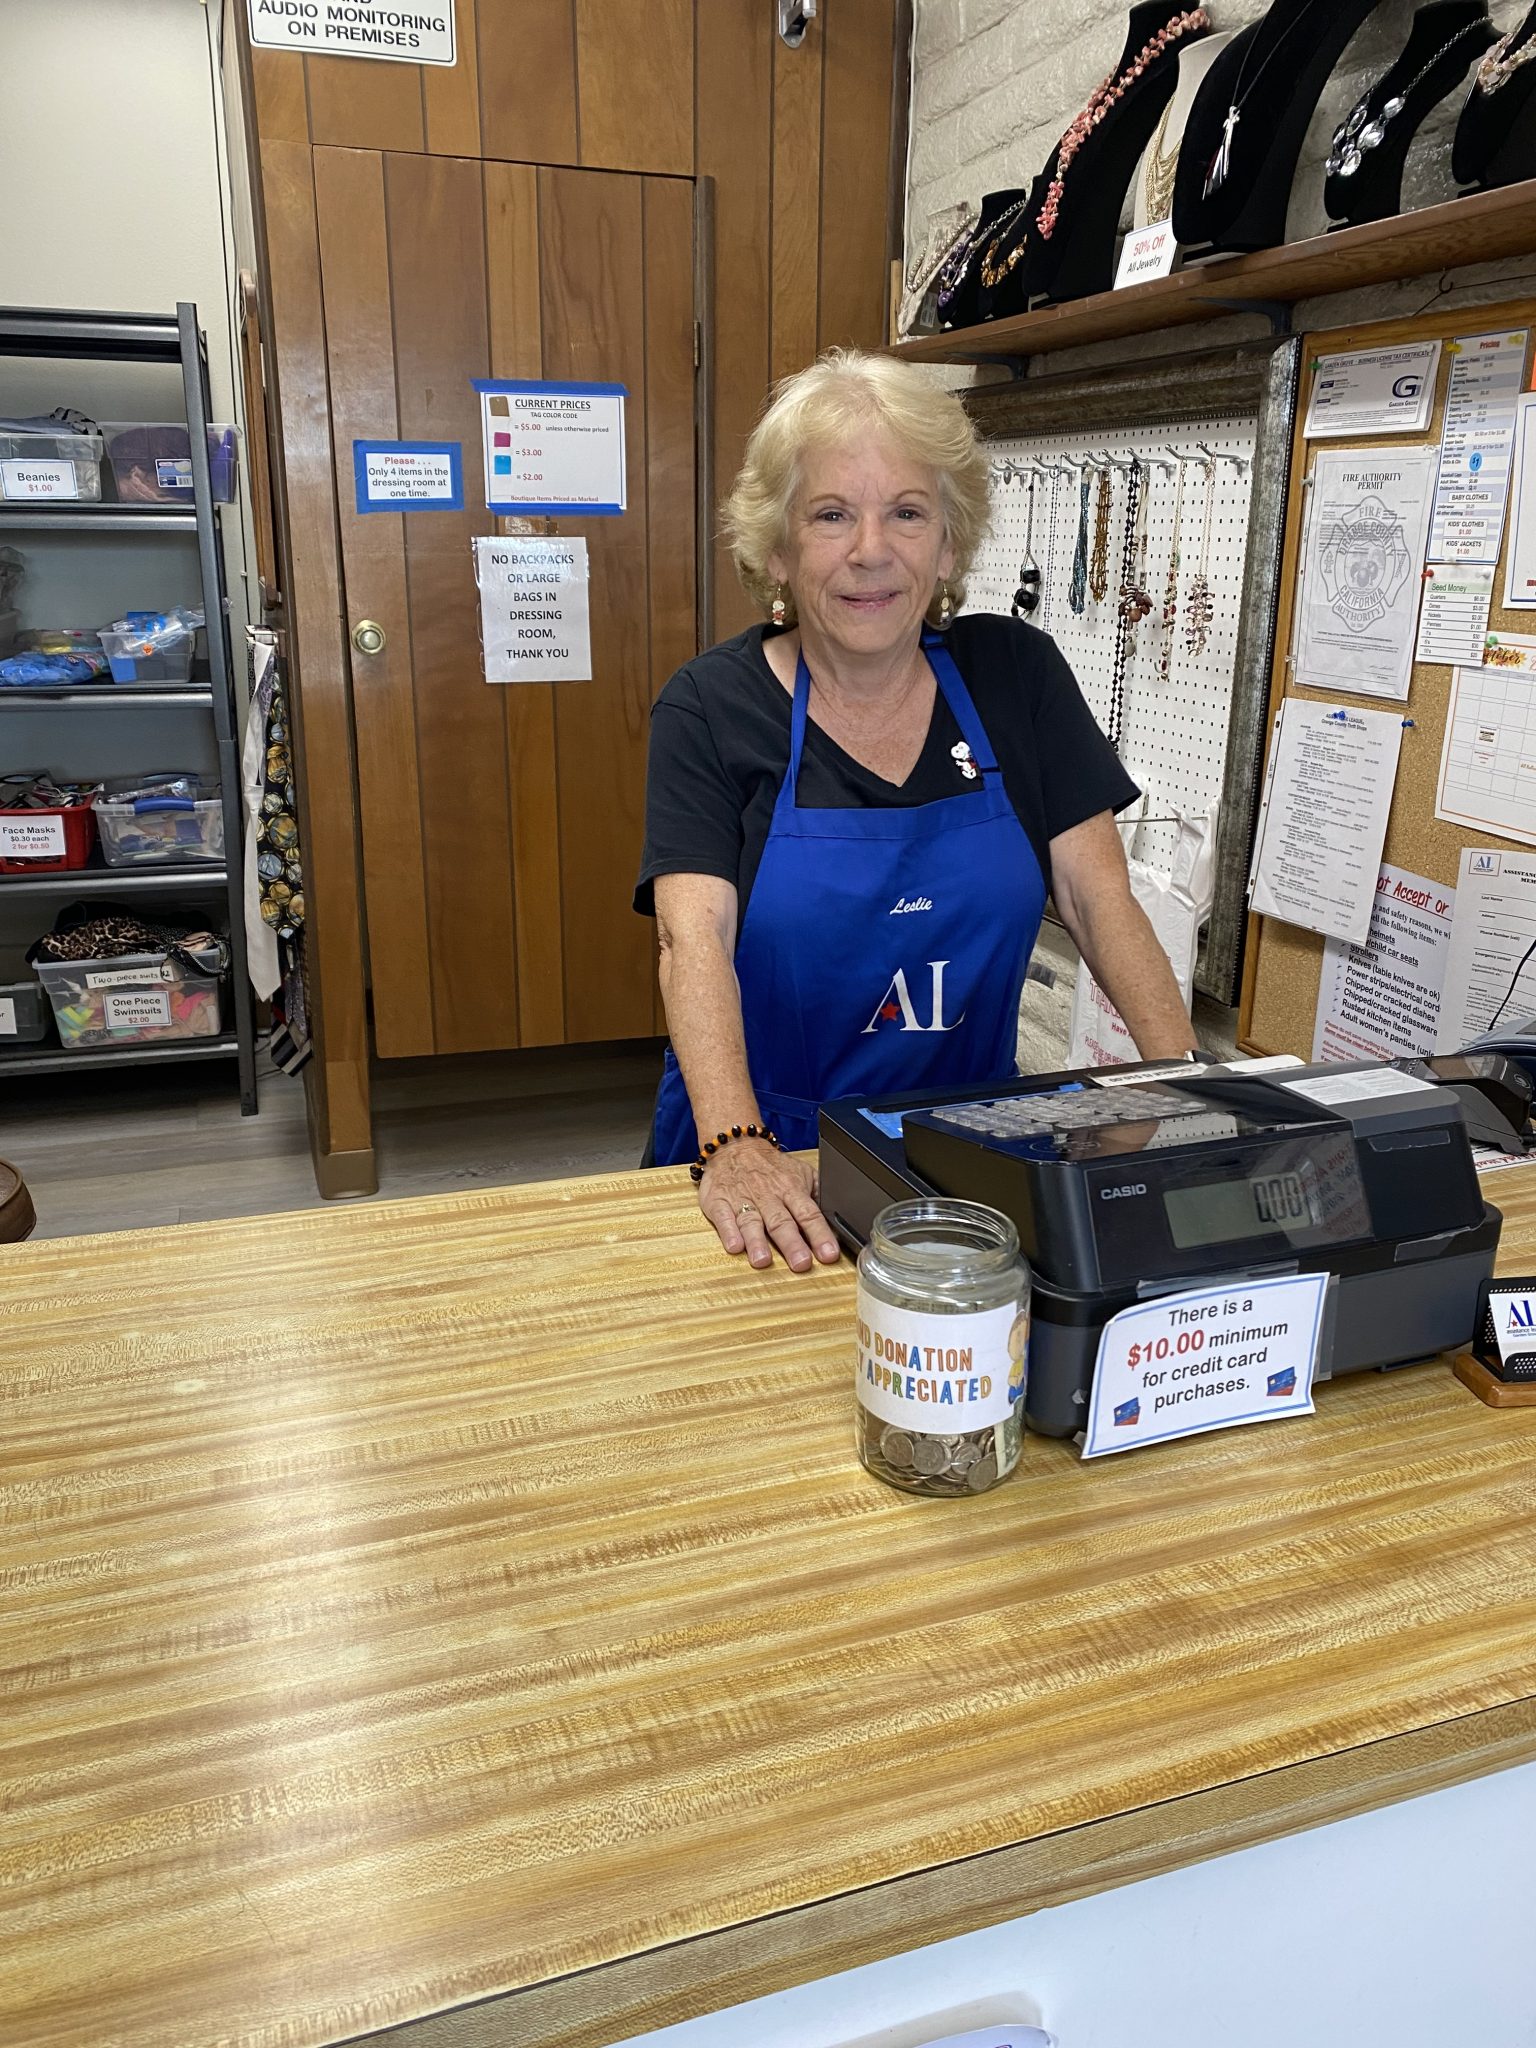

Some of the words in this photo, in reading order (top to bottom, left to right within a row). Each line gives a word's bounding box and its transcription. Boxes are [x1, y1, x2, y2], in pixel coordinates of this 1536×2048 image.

[258, 0, 318, 18] AUDIO
[327, 5, 446, 33] MONITORING
[287, 21, 316, 37] ON
[325, 24, 421, 48] PREMISES
[1133, 240, 1150, 256] 50%
[1152, 234, 1166, 250] Off
[1127, 260, 1136, 274] All
[1137, 255, 1162, 271] Jewelry
[515, 398, 558, 410] CURRENT
[560, 400, 591, 410] PRICES
[521, 423, 541, 431] $5.00
[17, 472, 61, 482] Beanies
[368, 468, 388, 477] Only
[398, 468, 422, 476] items
[1342, 474, 1359, 482] FIRE
[1361, 473, 1402, 481] AUTHORITY
[28, 484, 52, 492] $1.00
[372, 479, 410, 487] dressing
[1357, 482, 1384, 490] PERMIT
[1360, 506, 1381, 517] FIRE
[492, 555, 508, 564] NO
[512, 554, 574, 564] BACKPACKS
[508, 574, 523, 583] OR
[526, 574, 561, 582] LARGE
[1340, 584, 1384, 608] CALIFORNIA
[1432, 583, 1446, 591] Seed
[1448, 584, 1467, 593] Money
[514, 592, 542, 602] BAGS
[545, 592, 557, 601] IN
[510, 610, 562, 620] DRESSING
[1336, 604, 1380, 621] AUTHORITY
[518, 629, 556, 639] ROOM,
[506, 649, 543, 658] THANK
[546, 649, 569, 658] YOU
[27, 826, 56, 834] Masks
[1377, 876, 1391, 892] ot
[1393, 881, 1432, 908] Accept
[1436, 900, 1449, 914] or
[889, 897, 932, 915] Leslie
[1379, 906, 1389, 914] and
[1391, 910, 1408, 923] safety
[1409, 917, 1432, 932] reasons,
[1434, 928, 1442, 936] we
[1369, 928, 1395, 944] helmets
[1381, 917, 1389, 926] the
[1391, 921, 1418, 939] following
[1418, 932, 1437, 946] items:
[1350, 944, 1378, 961] Strollers
[1388, 948, 1399, 956] car
[1400, 953, 1419, 965] seats
[1347, 966, 1369, 980] Power
[1370, 976, 1422, 1004] strips/electrical
[1349, 954, 1372, 970] Knives
[1372, 964, 1391, 978] (table
[1393, 972, 1415, 988] knives
[1416, 985, 1427, 994] are
[1429, 990, 1440, 1002] ok)
[860, 960, 966, 1033] AL
[1346, 977, 1373, 995] Chipped
[1374, 990, 1382, 998] or
[1383, 994, 1411, 1012] cracked
[1413, 1006, 1435, 1022] dishes
[114, 1008, 161, 1016] Swimsuits
[1342, 999, 1365, 1015] Rusted
[1366, 1009, 1392, 1026] kitchen
[1393, 1021, 1412, 1036] items
[1344, 988, 1401, 1019] Chipped/cracked
[1402, 1015, 1437, 1036] glassware
[1112, 1022, 1126, 1036] Have
[1340, 1010, 1358, 1024] Adult
[1360, 1020, 1388, 1038] women's
[1390, 1034, 1416, 1050] panties
[1100, 1183, 1146, 1200] CASIO
[1169, 1304, 1217, 1327] There
[1223, 1299, 1240, 1316] is
[1242, 1299, 1253, 1312] a
[875, 1331, 972, 1372] DONATION
[1127, 1329, 1204, 1371] $10.00
[1209, 1322, 1288, 1348] minimum
[1142, 1369, 1167, 1388] for
[1172, 1355, 1223, 1381] credit
[1227, 1347, 1268, 1369] card
[867, 1359, 992, 1404] APPRECIATED
[1154, 1377, 1250, 1414] purchases.
